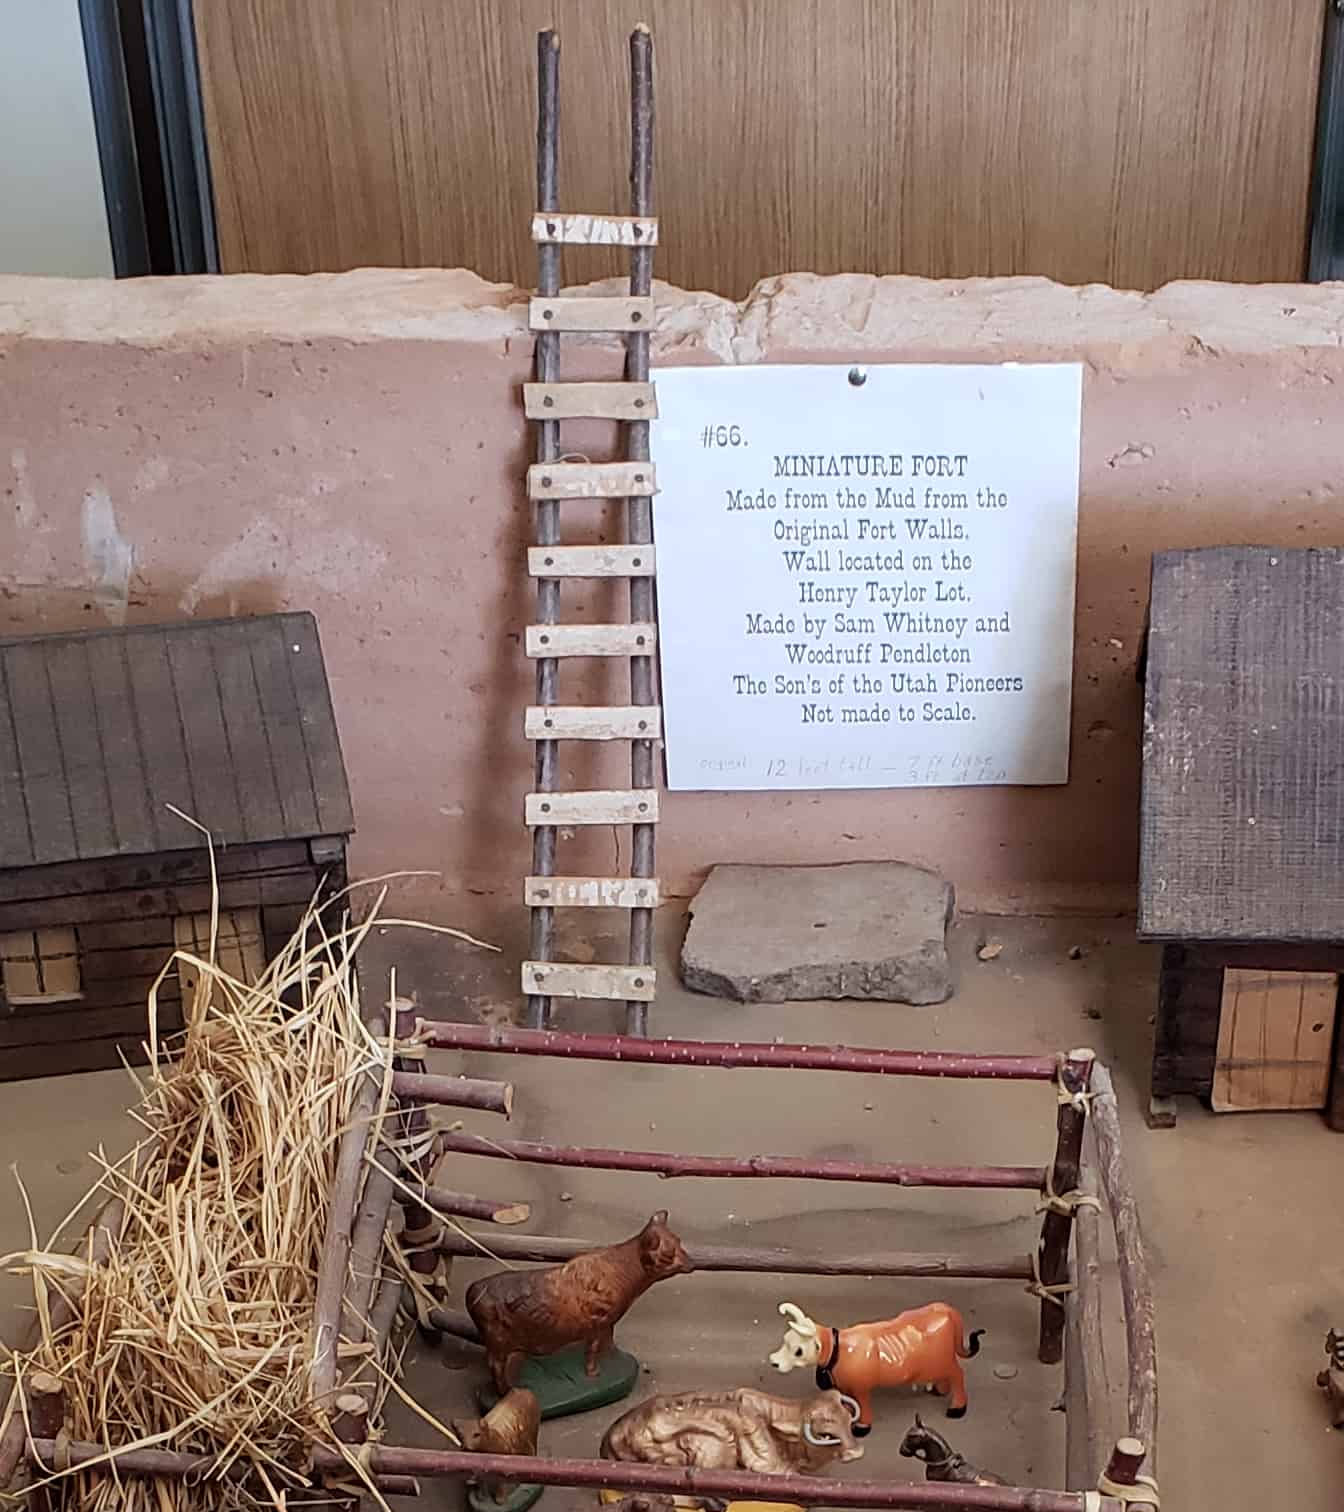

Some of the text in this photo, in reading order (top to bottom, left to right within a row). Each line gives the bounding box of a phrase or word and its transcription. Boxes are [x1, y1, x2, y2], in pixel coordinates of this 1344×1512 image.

[702, 425, 748, 448] #66.
[774, 455, 968, 477] MINIATURE FORT
[726, 488, 1007, 511] Made from the Mud from the
[774, 518, 968, 546] Original Fort Walls.
[782, 549, 971, 571] Wall located on the
[799, 581, 970, 608] Henry Taylor Lot.
[746, 612, 1010, 640] Made by Sam Whitney and
[785, 643, 970, 664] Woodruff Pendleton
[733, 673, 1023, 694] The Son's of the Utah Pioneers
[802, 702, 976, 723] Not made to Scale.
